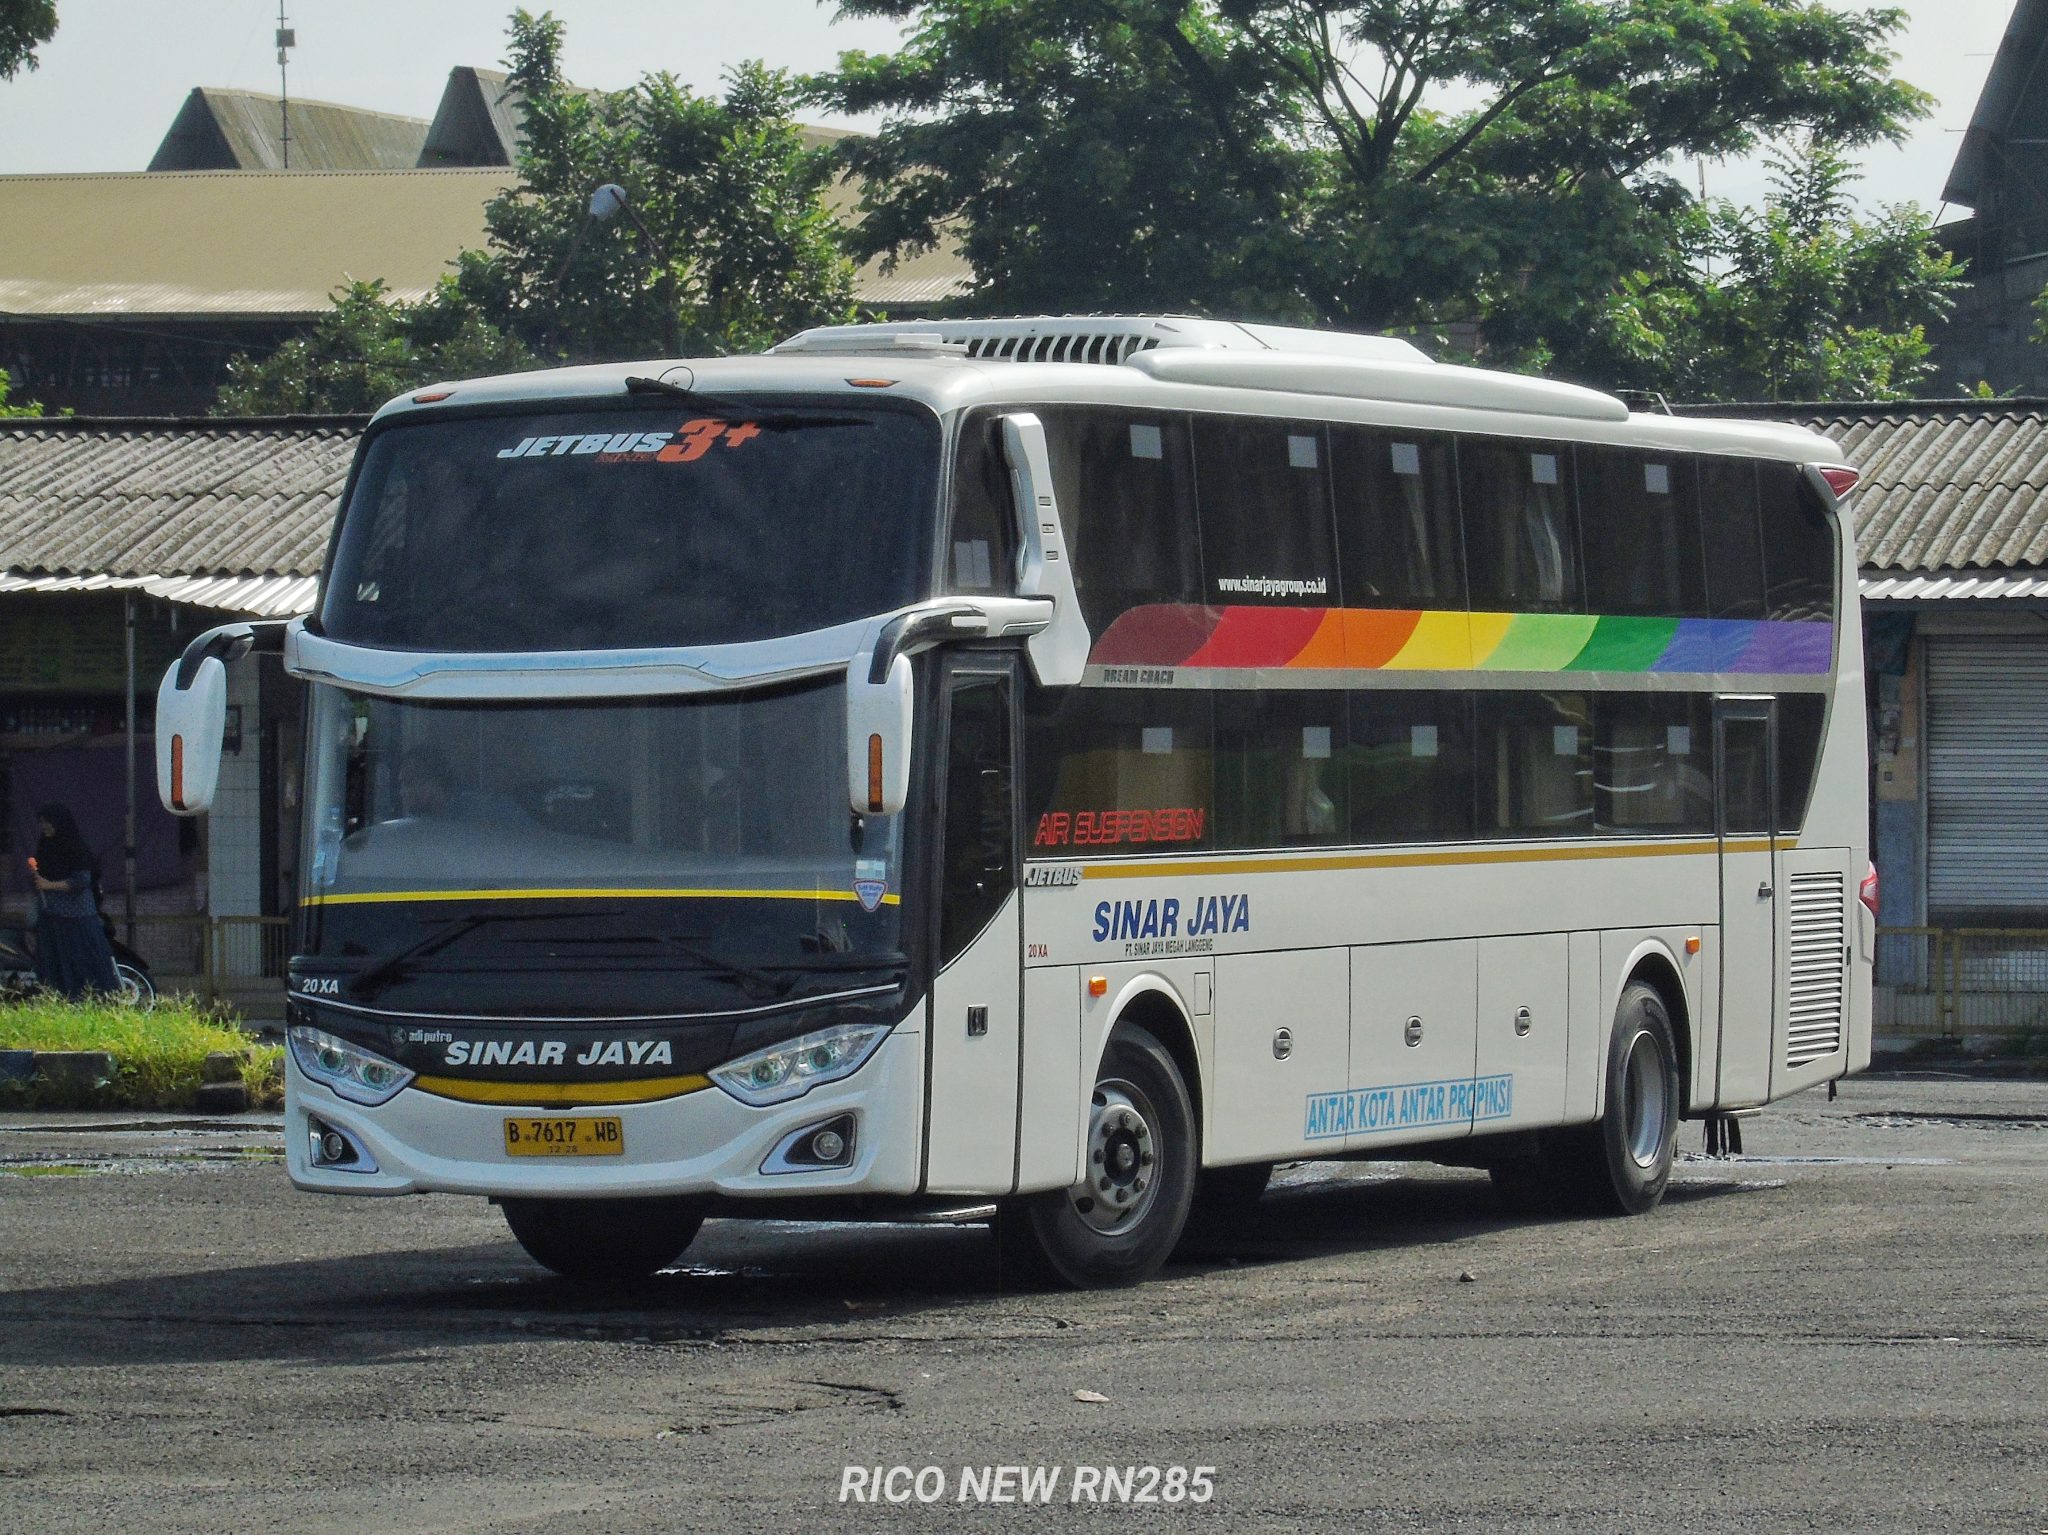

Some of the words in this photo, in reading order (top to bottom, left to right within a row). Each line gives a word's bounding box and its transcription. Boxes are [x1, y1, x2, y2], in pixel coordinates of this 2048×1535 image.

[497, 432, 674, 459] JETBUS
[1218, 575, 1327, 597] www.sinarjayagroup.co.id
[1103, 669, 1138, 684] DREAM
[1140, 670, 1175, 685] COACH
[1025, 866, 1083, 888] JETBUS
[1092, 897, 1180, 942] SINAR
[1187, 893, 1250, 937] JAYA
[1134, 942, 1151, 956] SINAR
[1151, 941, 1164, 955] JAYA
[1165, 940, 1184, 954] MEGAH
[445, 1041, 569, 1066] SINAR
[576, 1041, 673, 1066] JAYA
[1307, 1095, 1355, 1135] ANTAR
[1359, 1090, 1396, 1128] KOTA
[1399, 1085, 1446, 1125] ANTAR
[1449, 1078, 1512, 1118] PROPINSI
[508, 1122, 520, 1143] B
[531, 1121, 577, 1143] 7617
[594, 1121, 618, 1142] WB
